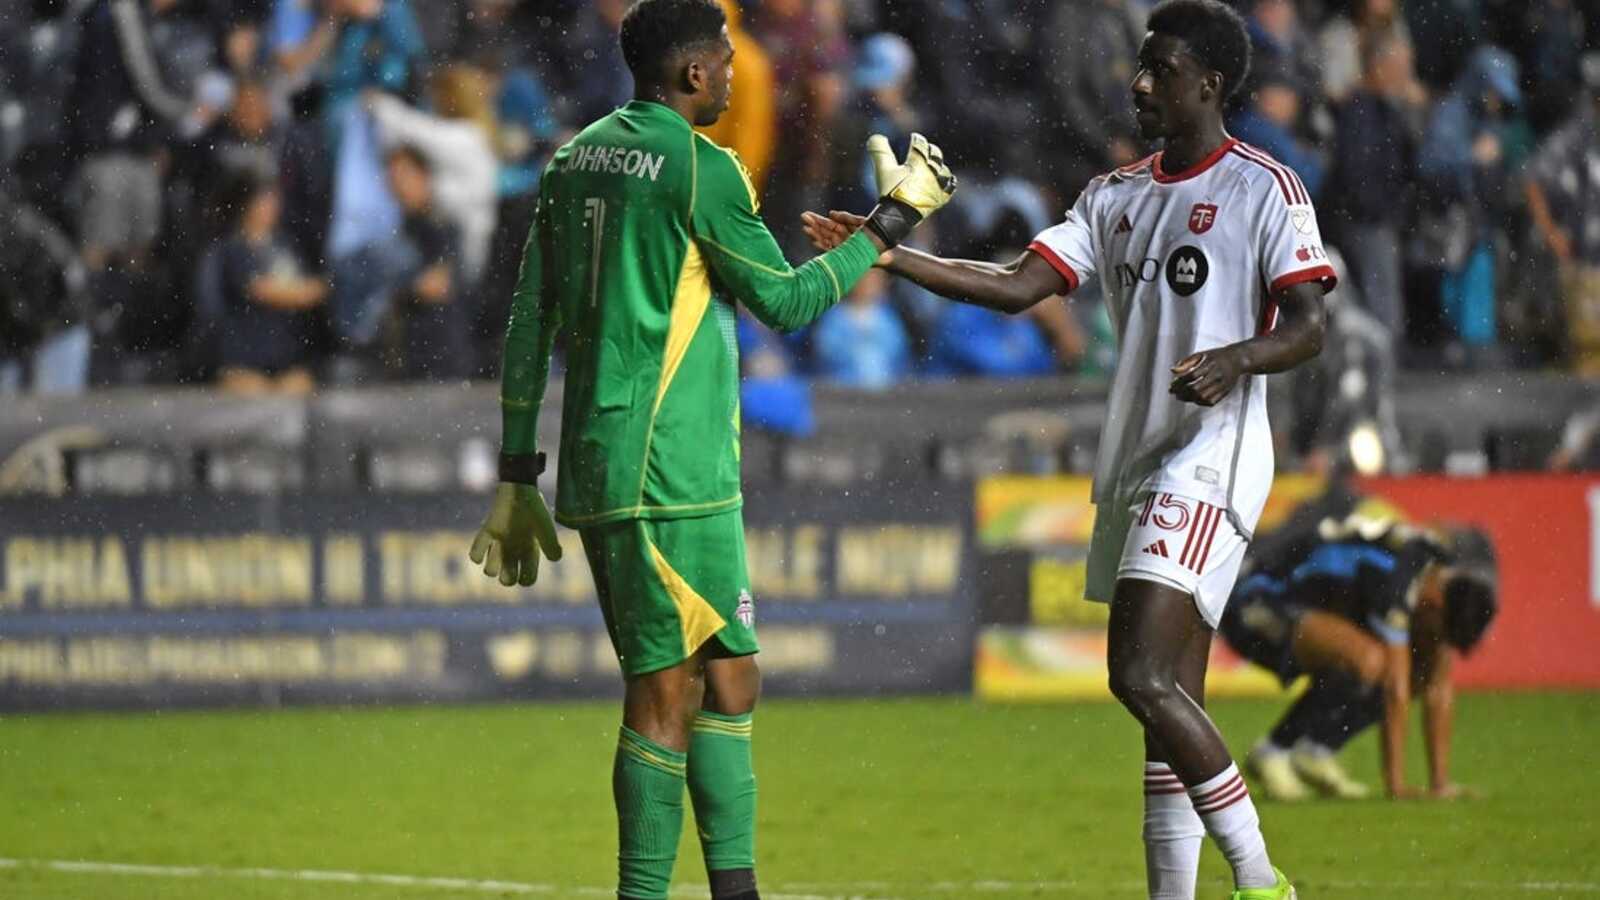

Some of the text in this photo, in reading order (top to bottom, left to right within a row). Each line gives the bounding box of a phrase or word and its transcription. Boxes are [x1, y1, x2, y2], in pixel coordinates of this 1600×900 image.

[560, 145, 665, 182] JOHNSON
[585, 197, 607, 308] 1
[1138, 492, 1191, 532] 15
